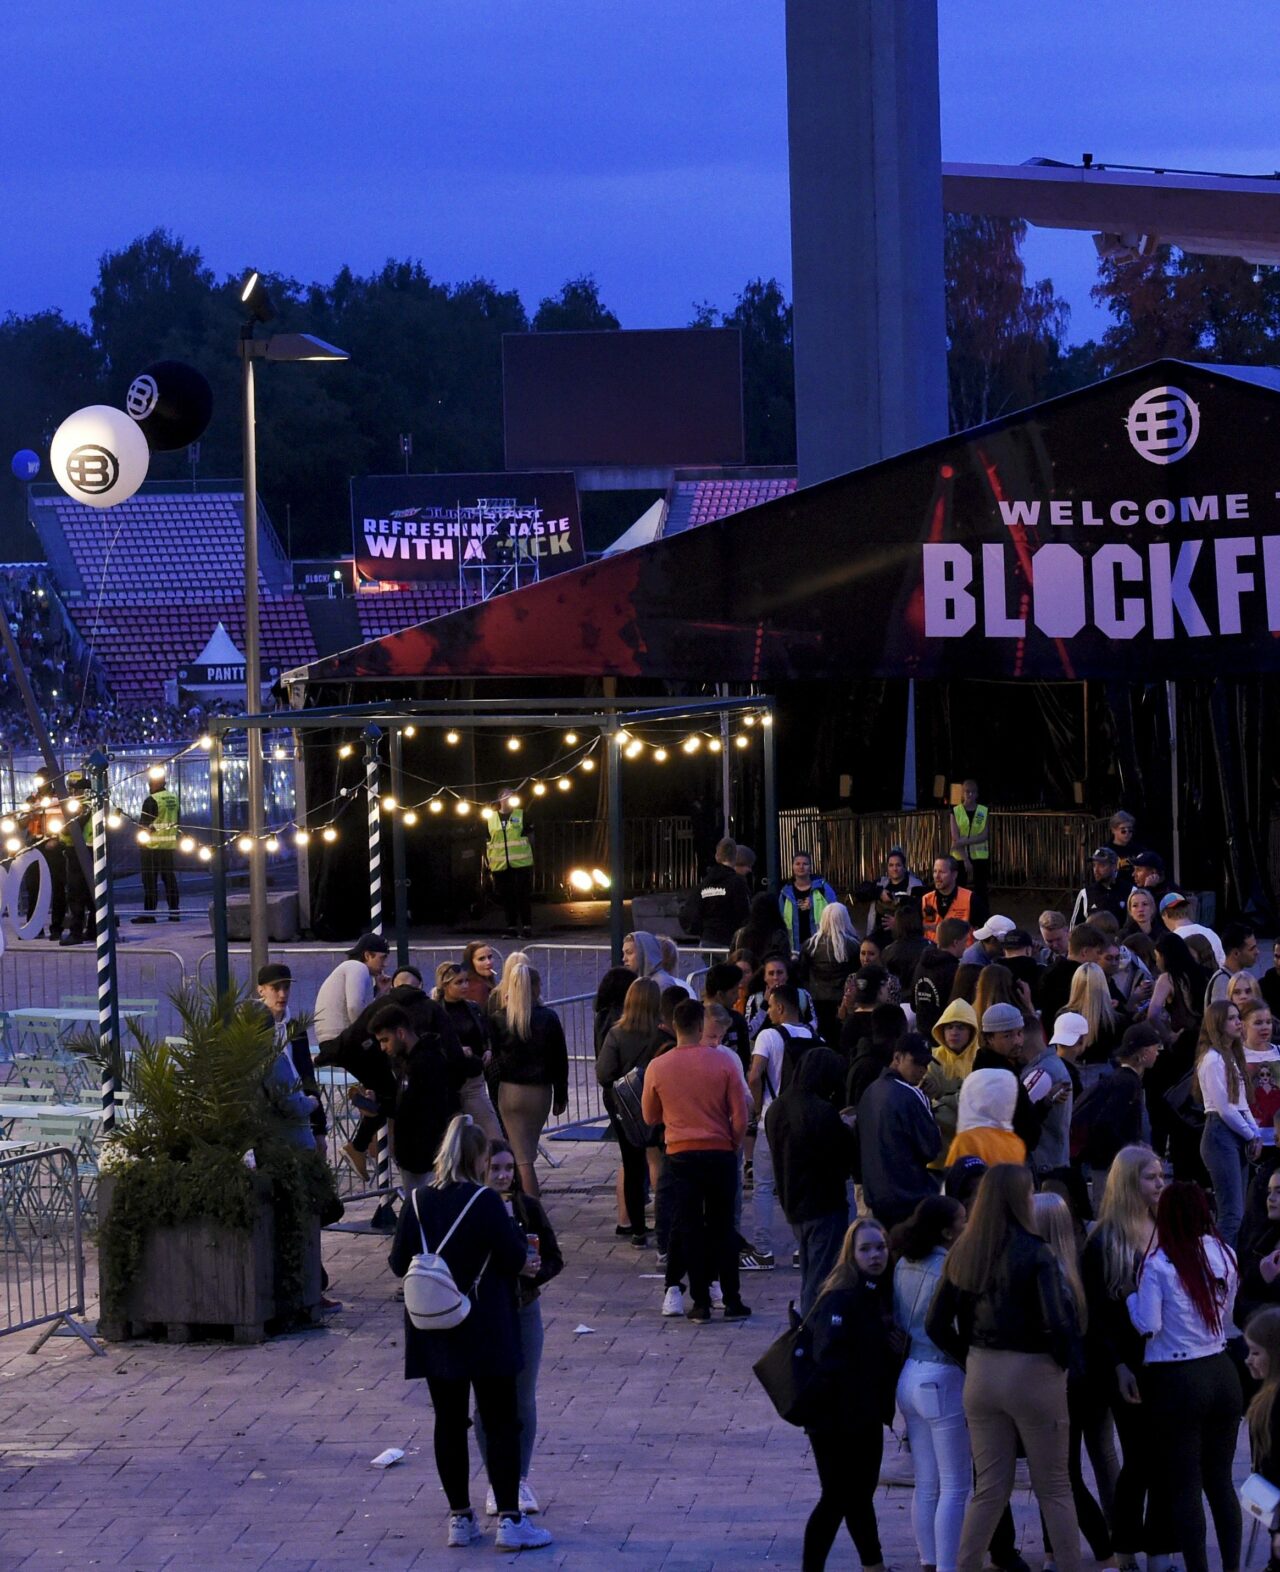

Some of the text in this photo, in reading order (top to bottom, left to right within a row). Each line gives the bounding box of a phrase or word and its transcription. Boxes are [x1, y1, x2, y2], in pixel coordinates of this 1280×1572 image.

[998, 493, 1250, 526] WELCOME
[510, 517, 570, 537] TASTE
[364, 535, 454, 560] WITH
[464, 538, 486, 560] A
[207, 667, 246, 681] PANTT
